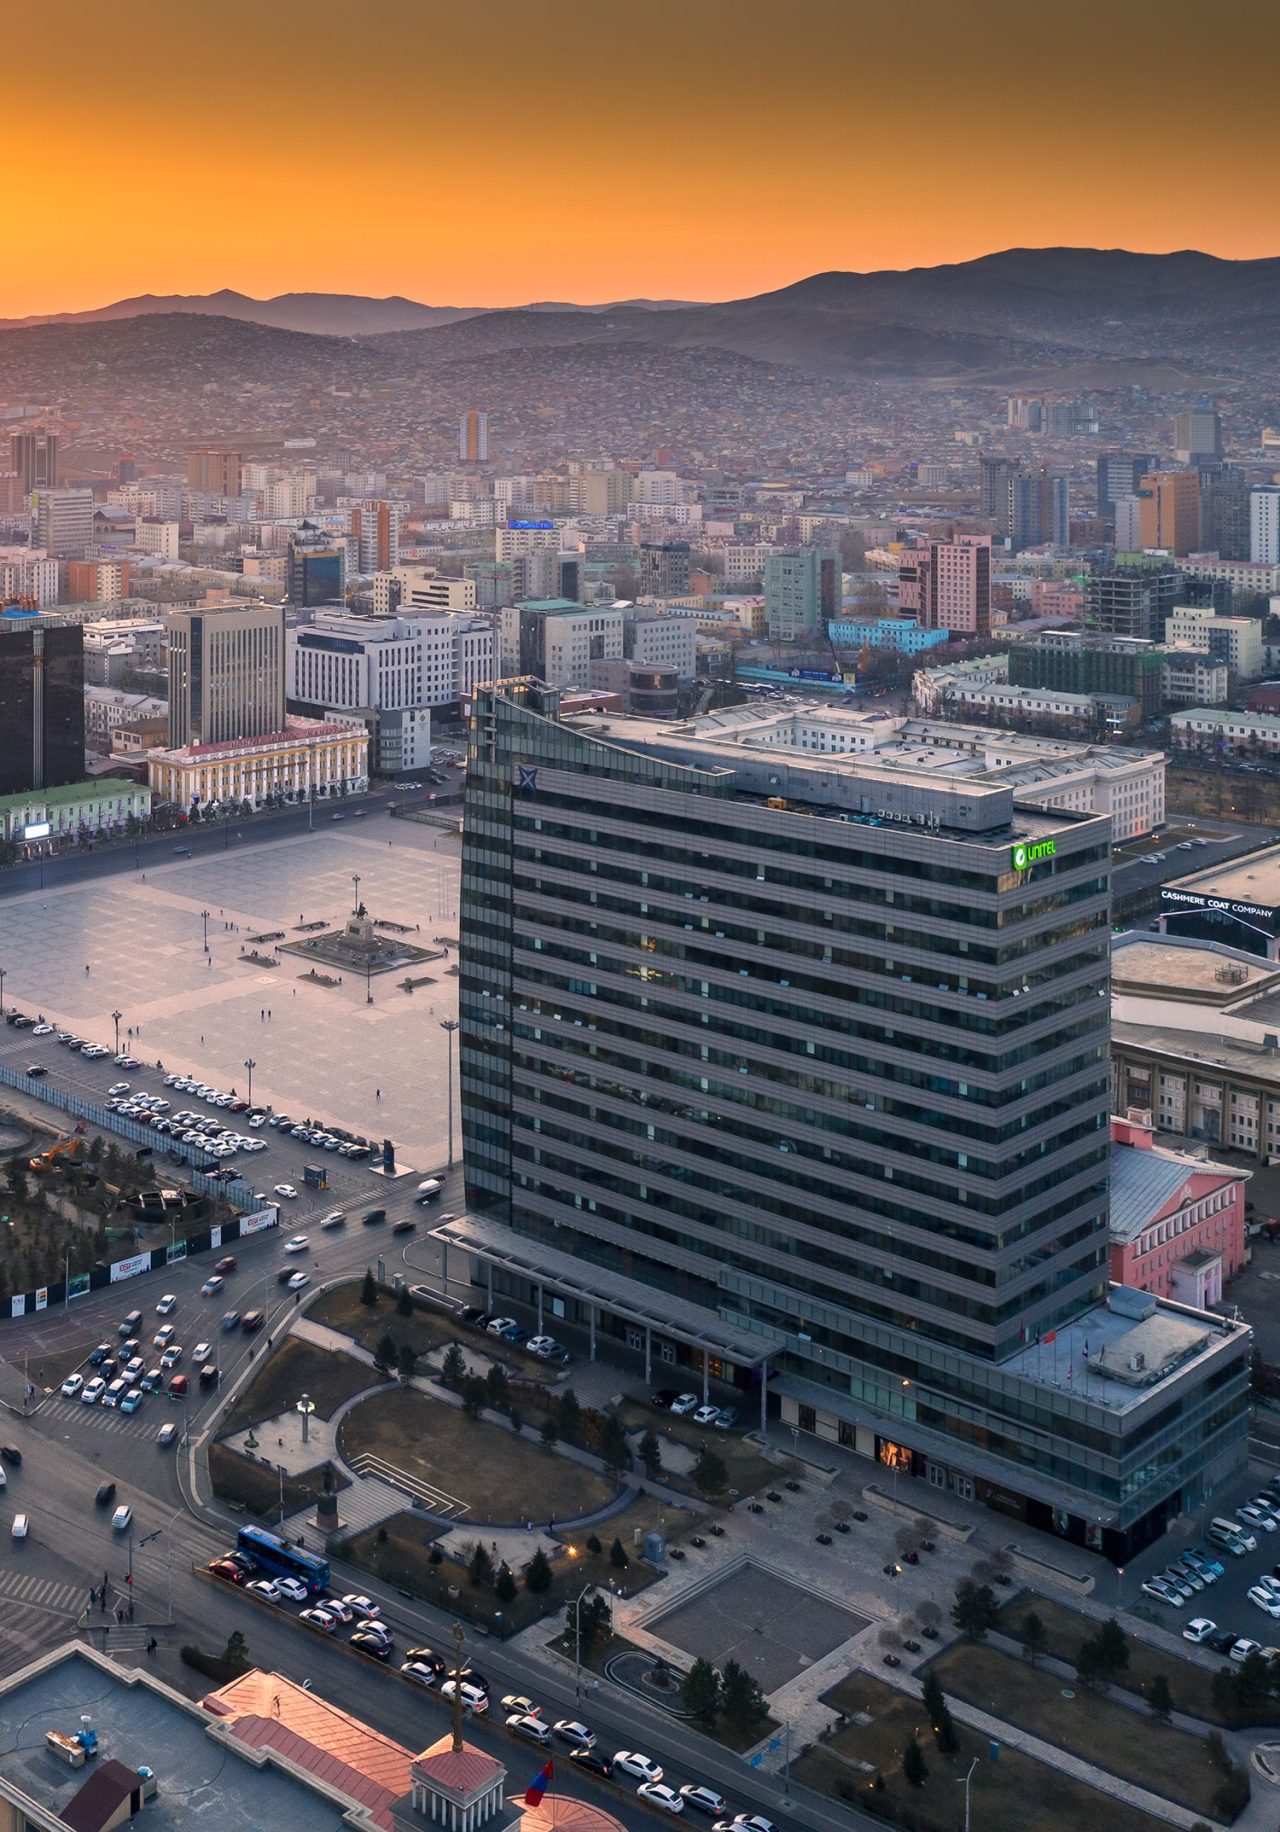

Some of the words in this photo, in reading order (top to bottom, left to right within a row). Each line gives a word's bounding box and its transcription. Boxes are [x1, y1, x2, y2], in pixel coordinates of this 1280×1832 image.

[1028, 840, 1056, 861] UNITEL
[1161, 890, 1205, 906] CASHMERE
[1207, 899, 1230, 910] COAT
[1232, 903, 1273, 918] COMPANY
